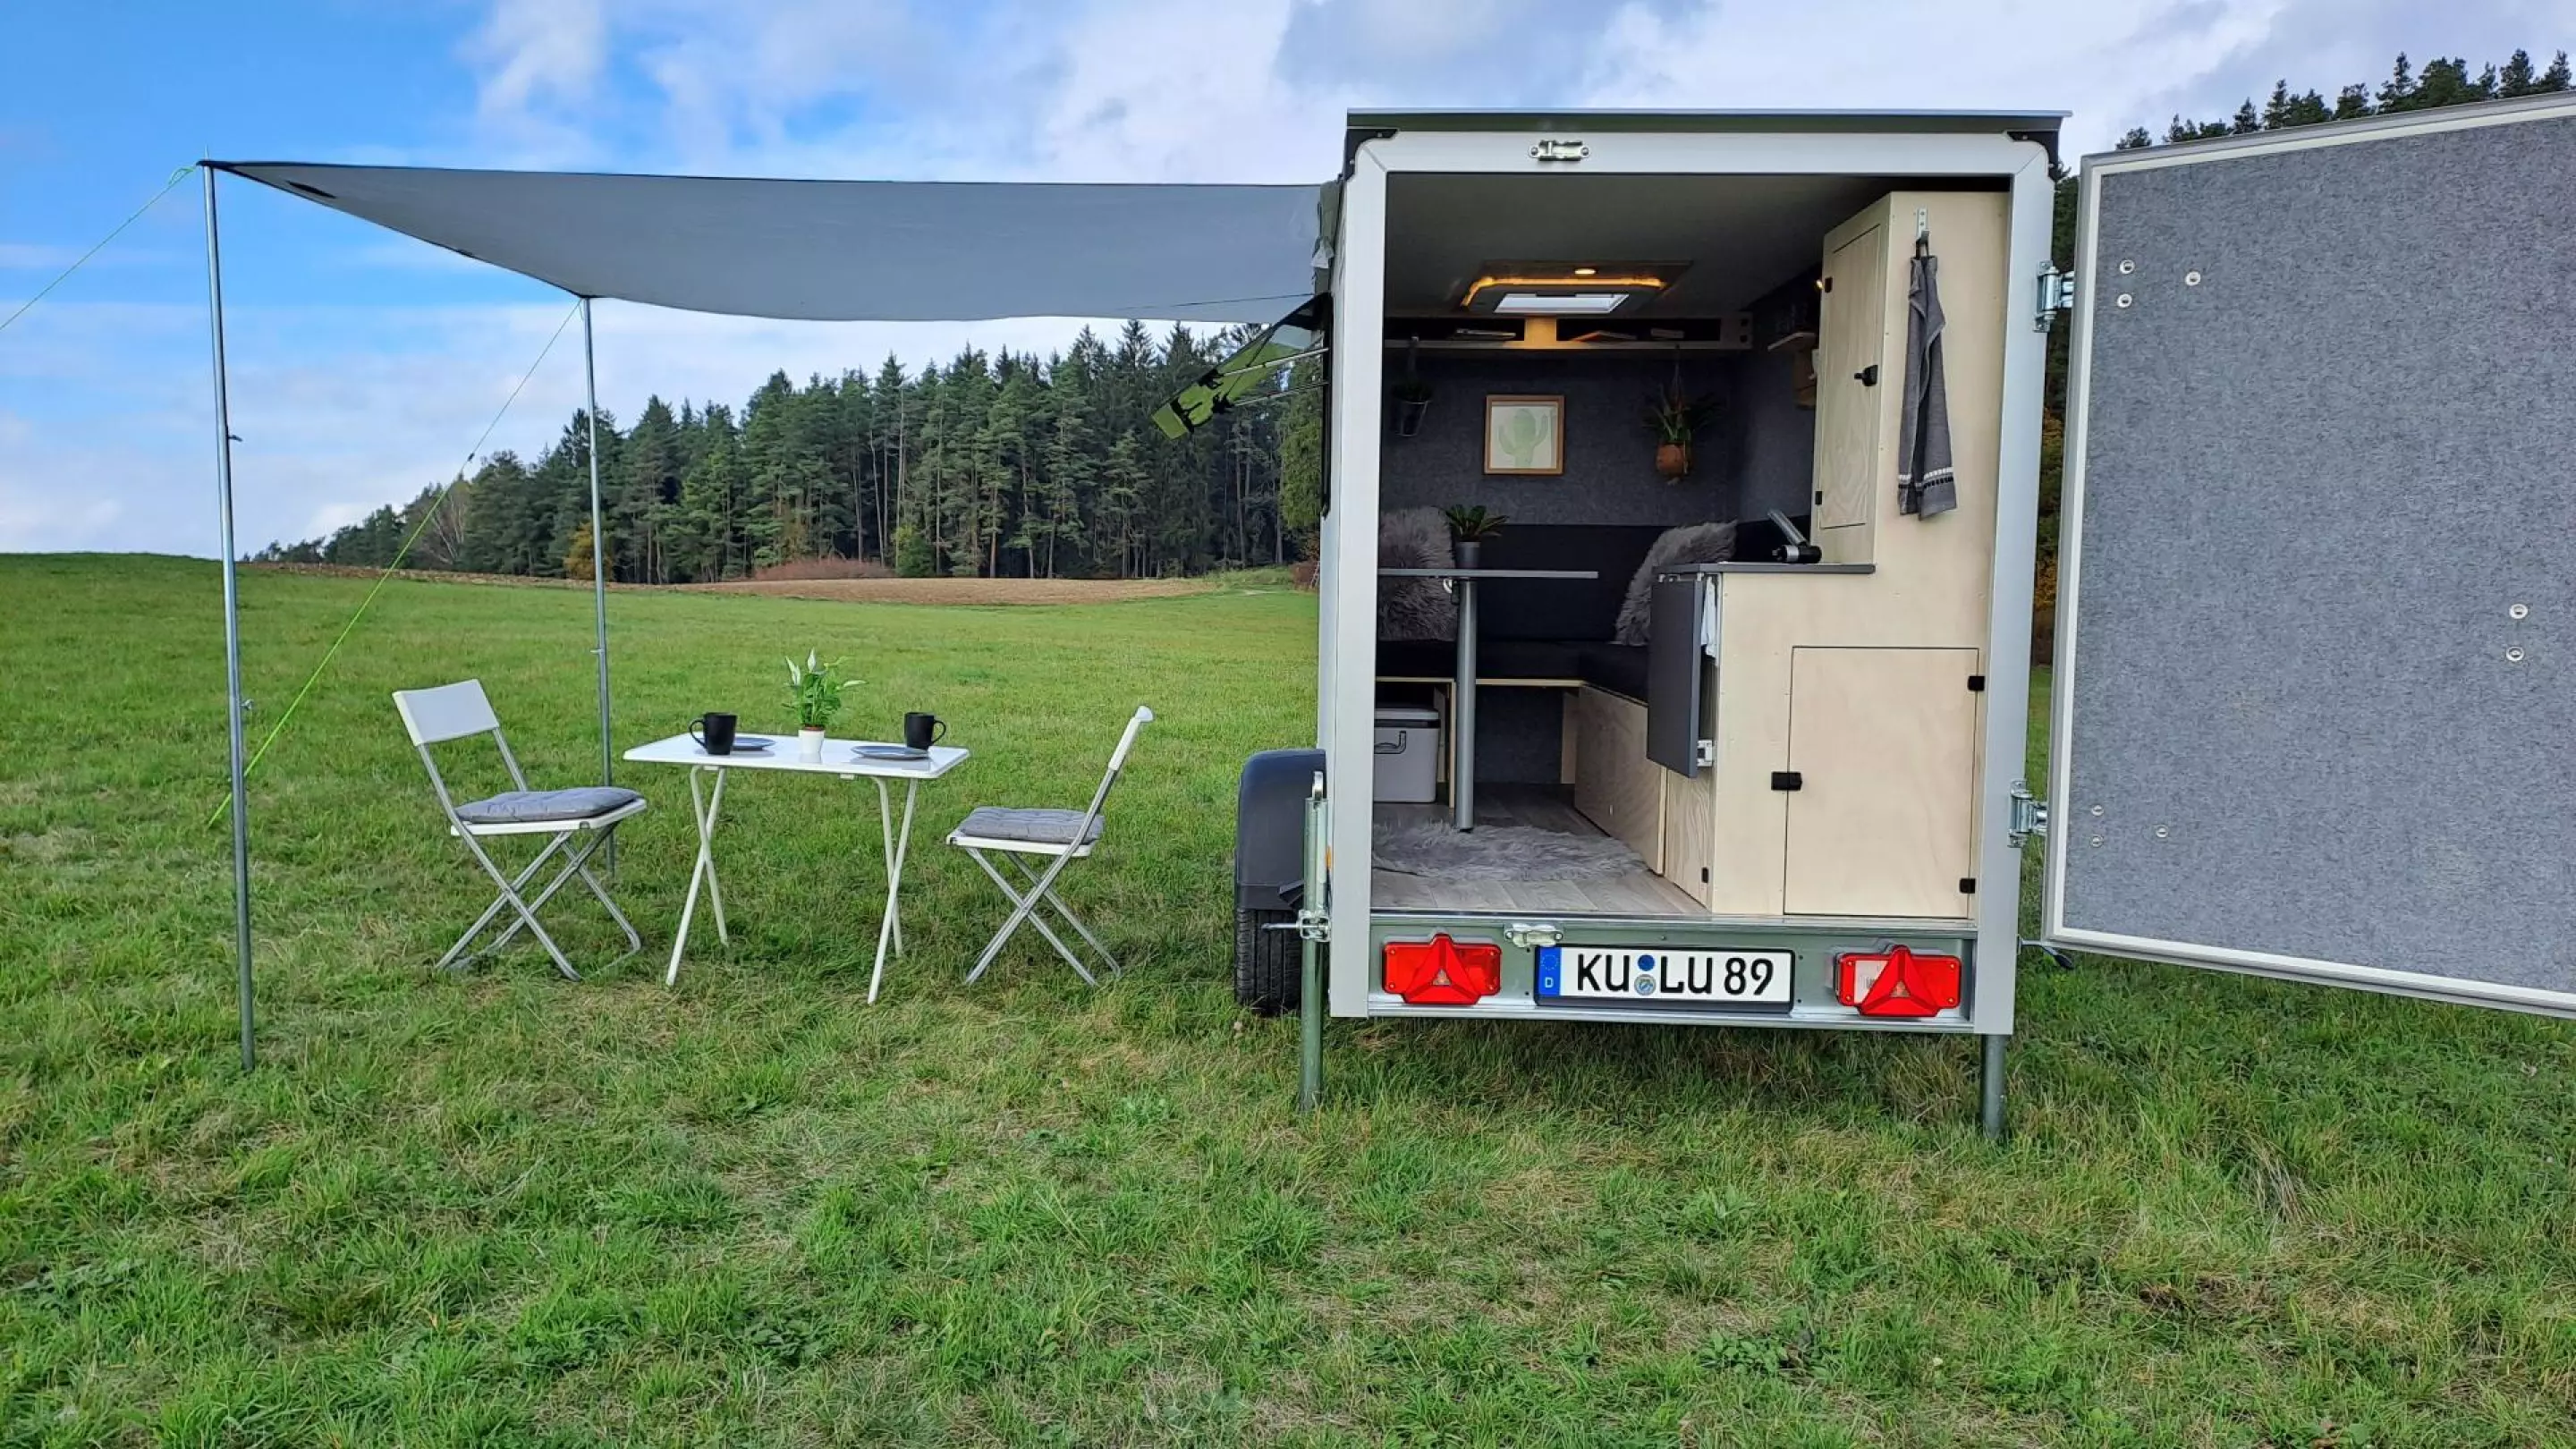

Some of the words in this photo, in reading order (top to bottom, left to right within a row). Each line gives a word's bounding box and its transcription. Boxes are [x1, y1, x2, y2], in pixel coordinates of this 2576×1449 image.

[1545, 977, 1555, 988] D
[1577, 953, 1631, 992] KU
[1659, 955, 1713, 994] LU
[1724, 957, 1774, 996] 89
